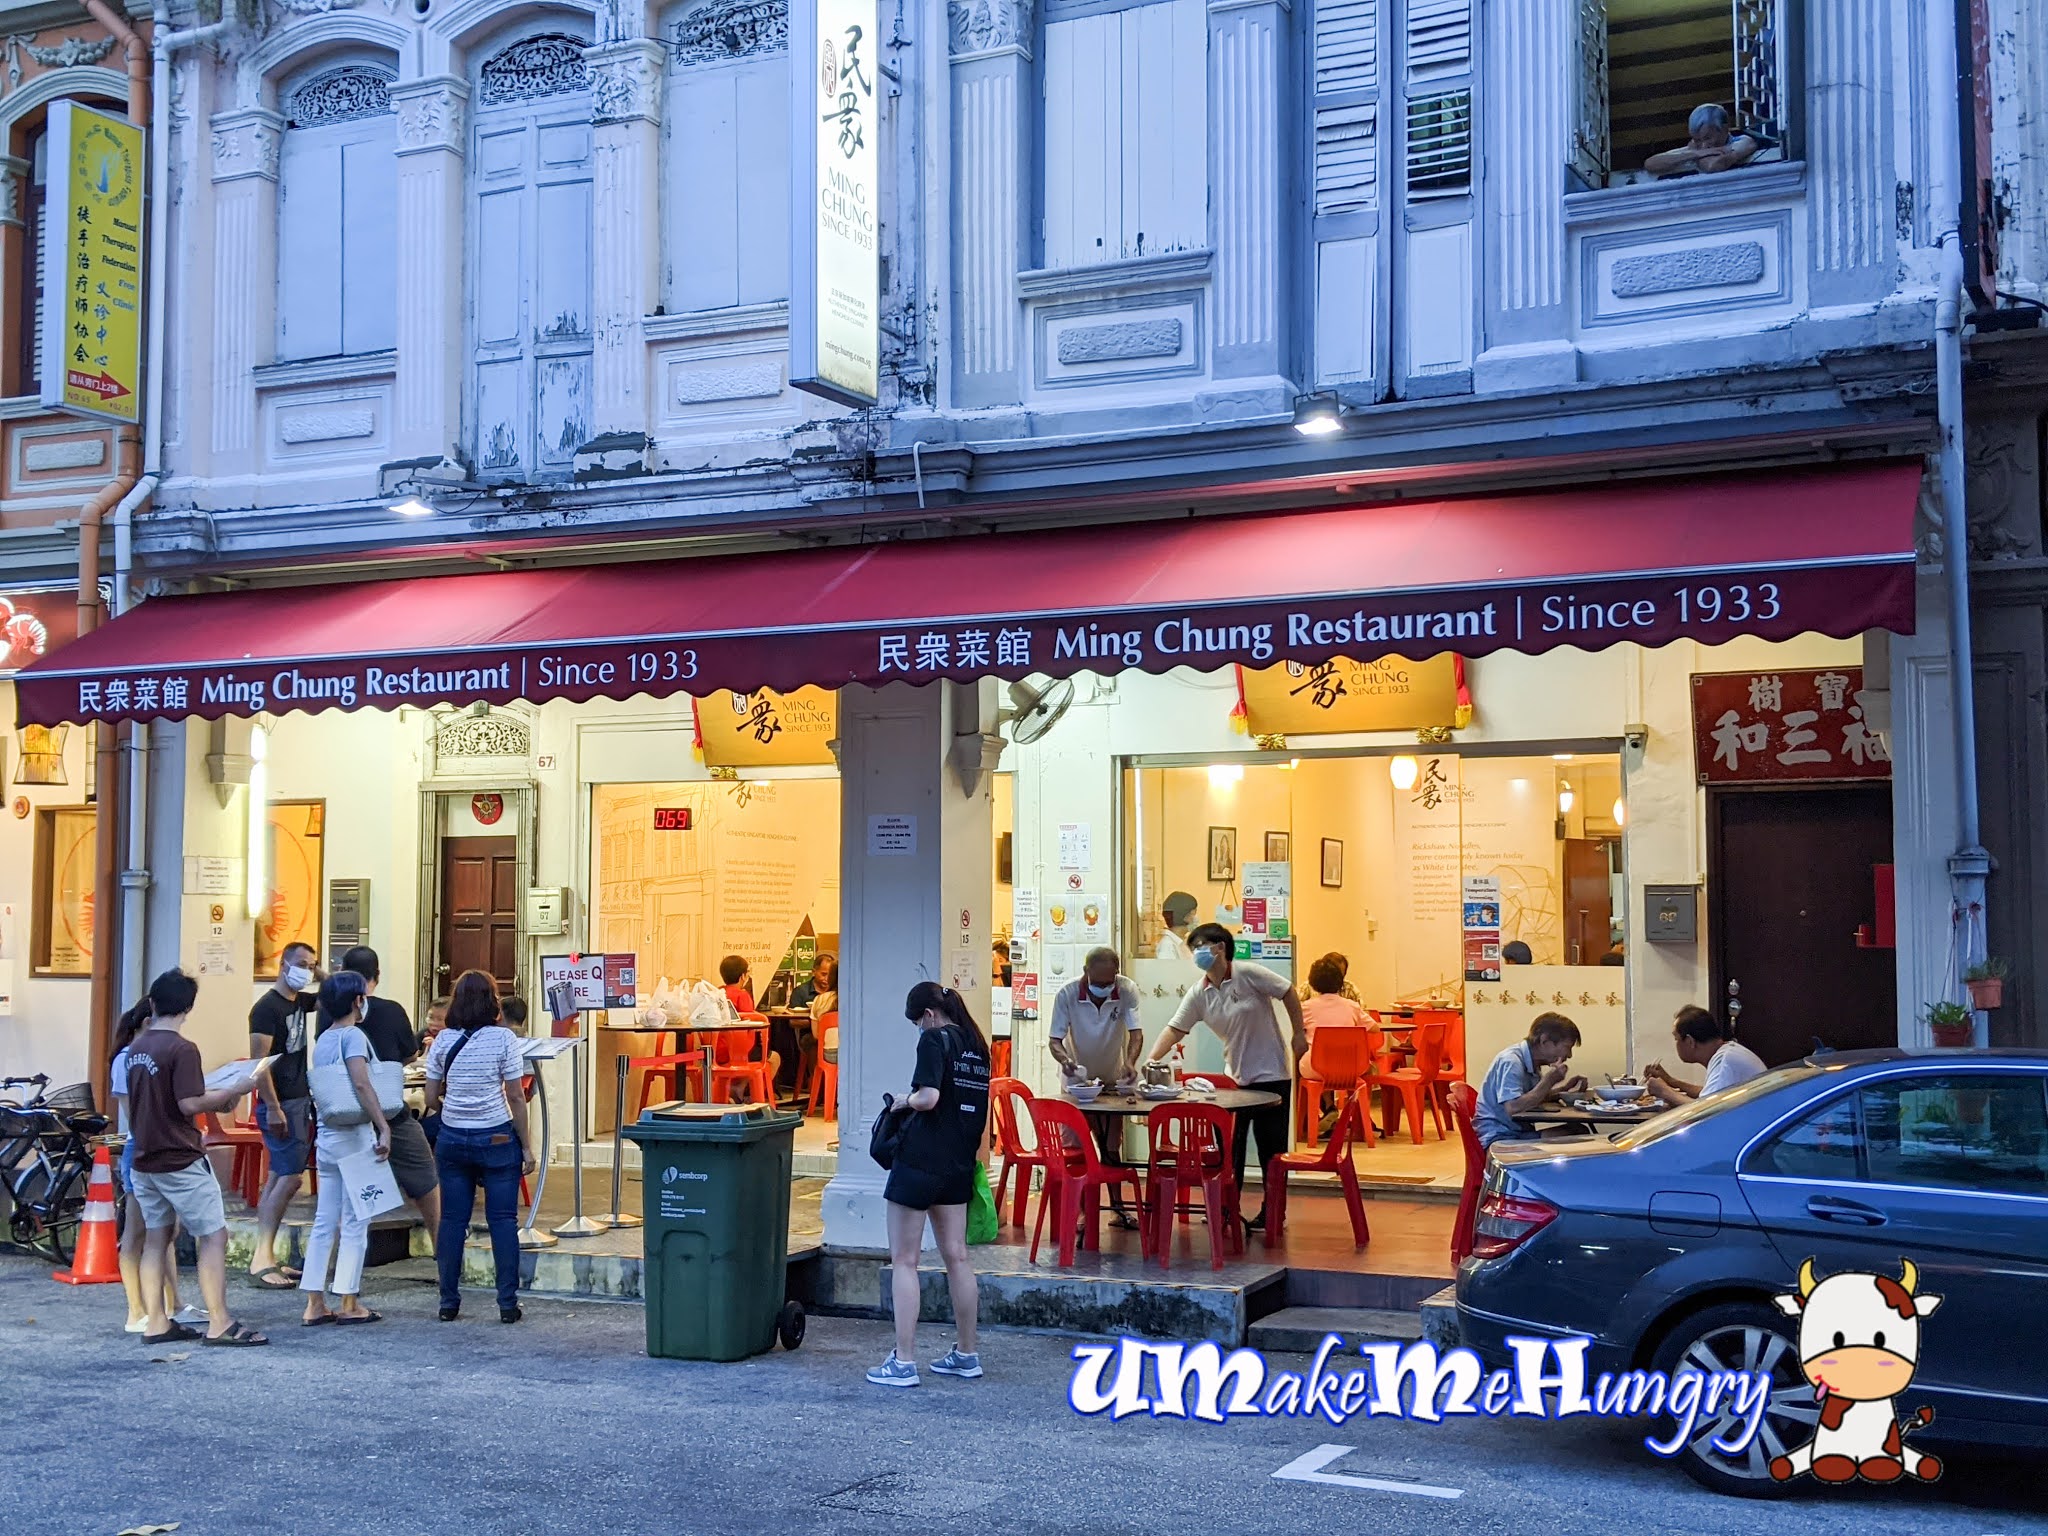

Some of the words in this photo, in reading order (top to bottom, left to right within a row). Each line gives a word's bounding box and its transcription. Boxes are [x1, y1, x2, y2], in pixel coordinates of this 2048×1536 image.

[829, 166, 865, 205] MING
[822, 188, 873, 232] CHUNG
[113, 217, 137, 232] Manual
[822, 212, 850, 240] SINCE
[853, 228, 873, 250] 1933
[102, 234, 136, 253] Therapists
[102, 255, 136, 272] Federation
[825, 340, 872, 369] mingchung.com.sg
[1053, 623, 1143, 666] Ming
[1154, 617, 1274, 659] Chung
[1287, 602, 1498, 646] Restaurant
[1541, 594, 1656, 632] Since
[1673, 583, 1782, 622] 1933
[1350, 659, 1391, 673] MING
[201, 673, 265, 710] Ming
[272, 669, 356, 706] Chung
[365, 661, 510, 696] Restaurant
[538, 656, 615, 687] Since
[626, 650, 698, 682] 1933
[1351, 671, 1409, 686] CHUNG
[1352, 687, 1384, 696] SINCE
[1388, 685, 1410, 694] 1933
[782, 700, 816, 712] MING
[784, 711, 830, 724] CHUNG
[786, 724, 812, 732] SINCE
[814, 723, 832, 732] 1933
[538, 756, 553, 767] 67
[655, 810, 688, 828] 069
[1449, 842, 1481, 850] Nodles,
[1434, 853, 1473, 861] commnly
[1475, 852, 1500, 860] known
[1503, 852, 1524, 861] today
[1423, 863, 1444, 871] White
[213, 927, 222, 935] 12
[962, 934, 969, 943] 15
[723, 941, 732, 949] The
[733, 942, 744, 951] year
[762, 941, 771, 950] and
[764, 954, 772, 962] the
[546, 969, 588, 981] PLEASE
[591, 965, 602, 980] Q
[574, 987, 589, 997] RE
[679, 1171, 708, 1182] sembcorp
